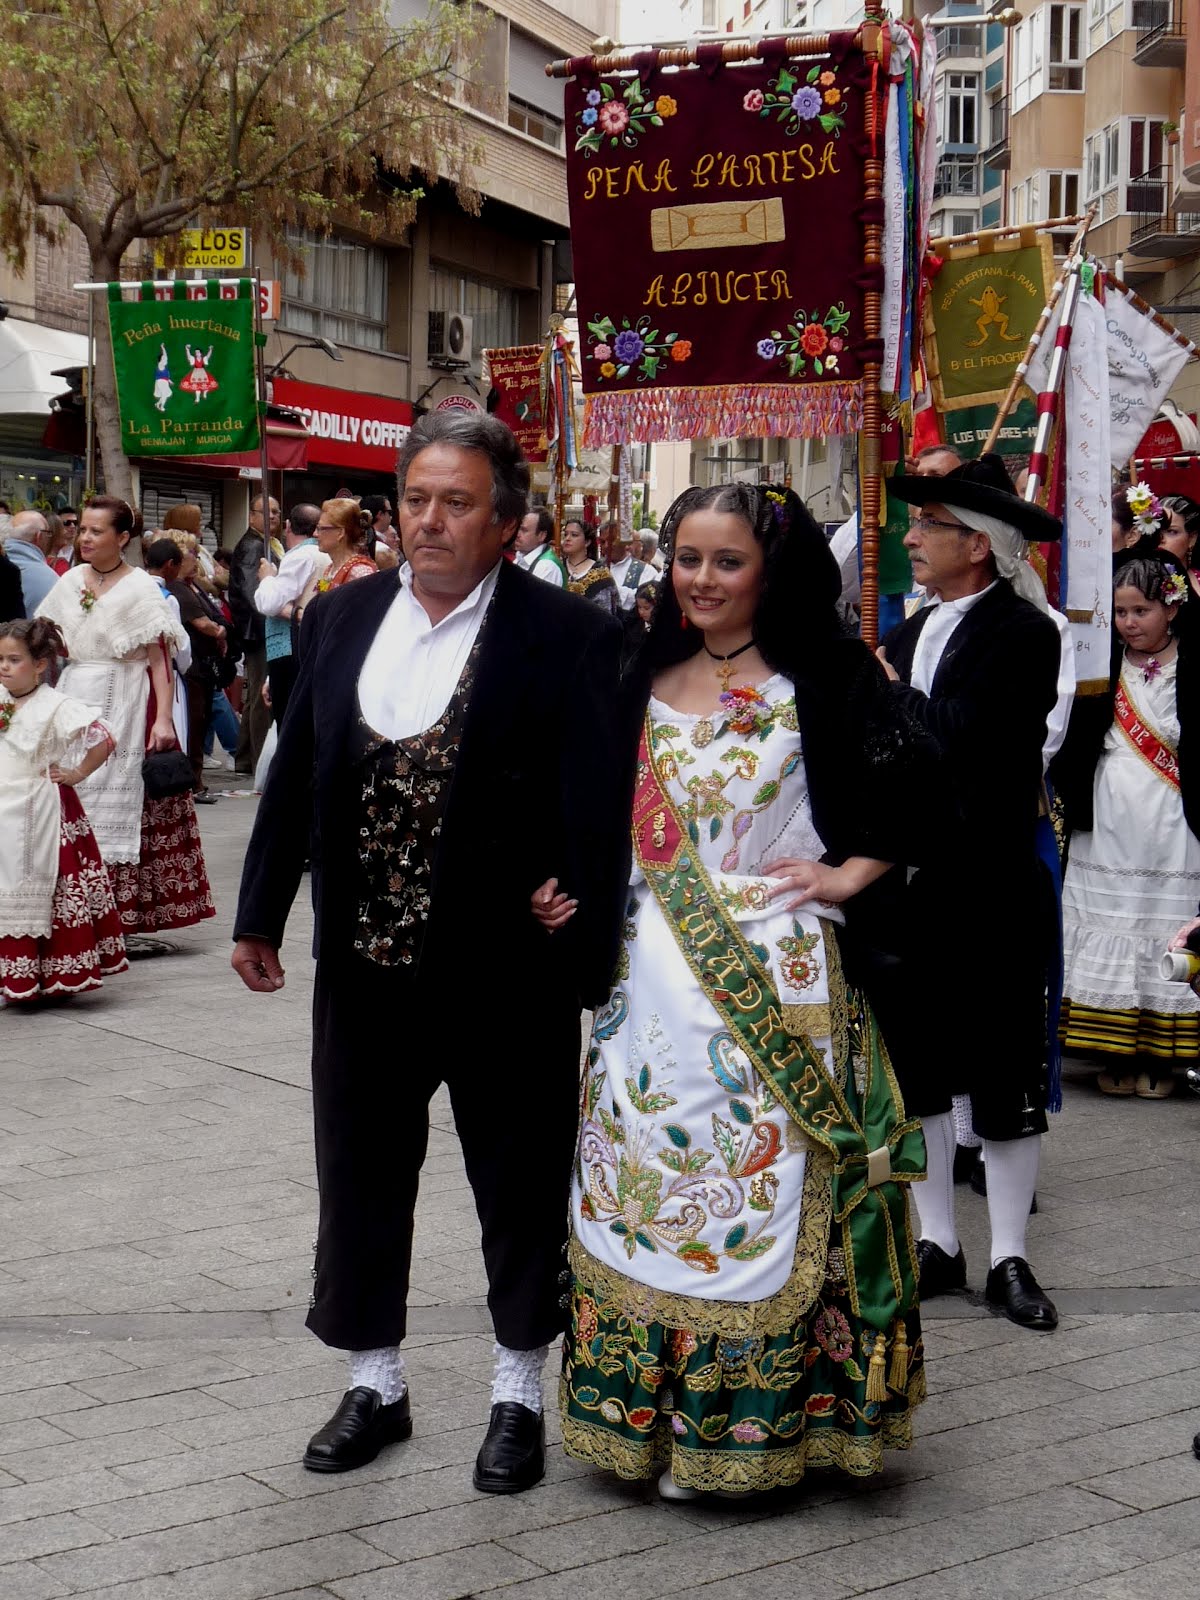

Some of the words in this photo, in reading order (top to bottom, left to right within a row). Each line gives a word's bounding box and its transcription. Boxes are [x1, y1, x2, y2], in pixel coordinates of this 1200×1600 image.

[584, 159, 677, 200] PEÑA
[691, 142, 840, 188] L'ARTESA
[186, 255, 236, 265] CAUCHO
[643, 269, 792, 307] ALJUCER
[956, 267, 1003, 289] HUERTANA
[1017, 274, 1038, 297] RANA
[123, 322, 162, 346] Peña
[169, 315, 241, 341] huertana
[1106, 319, 1134, 348] Coros
[964, 358, 978, 369] EL
[981, 350, 1027, 367] PROGRE
[128, 420, 151, 434] La
[160, 416, 245, 433] Parranda
[196, 434, 232, 444] MURCIA
[953, 430, 975, 444] LOS
[685, 902, 843, 1135] MADRINA
